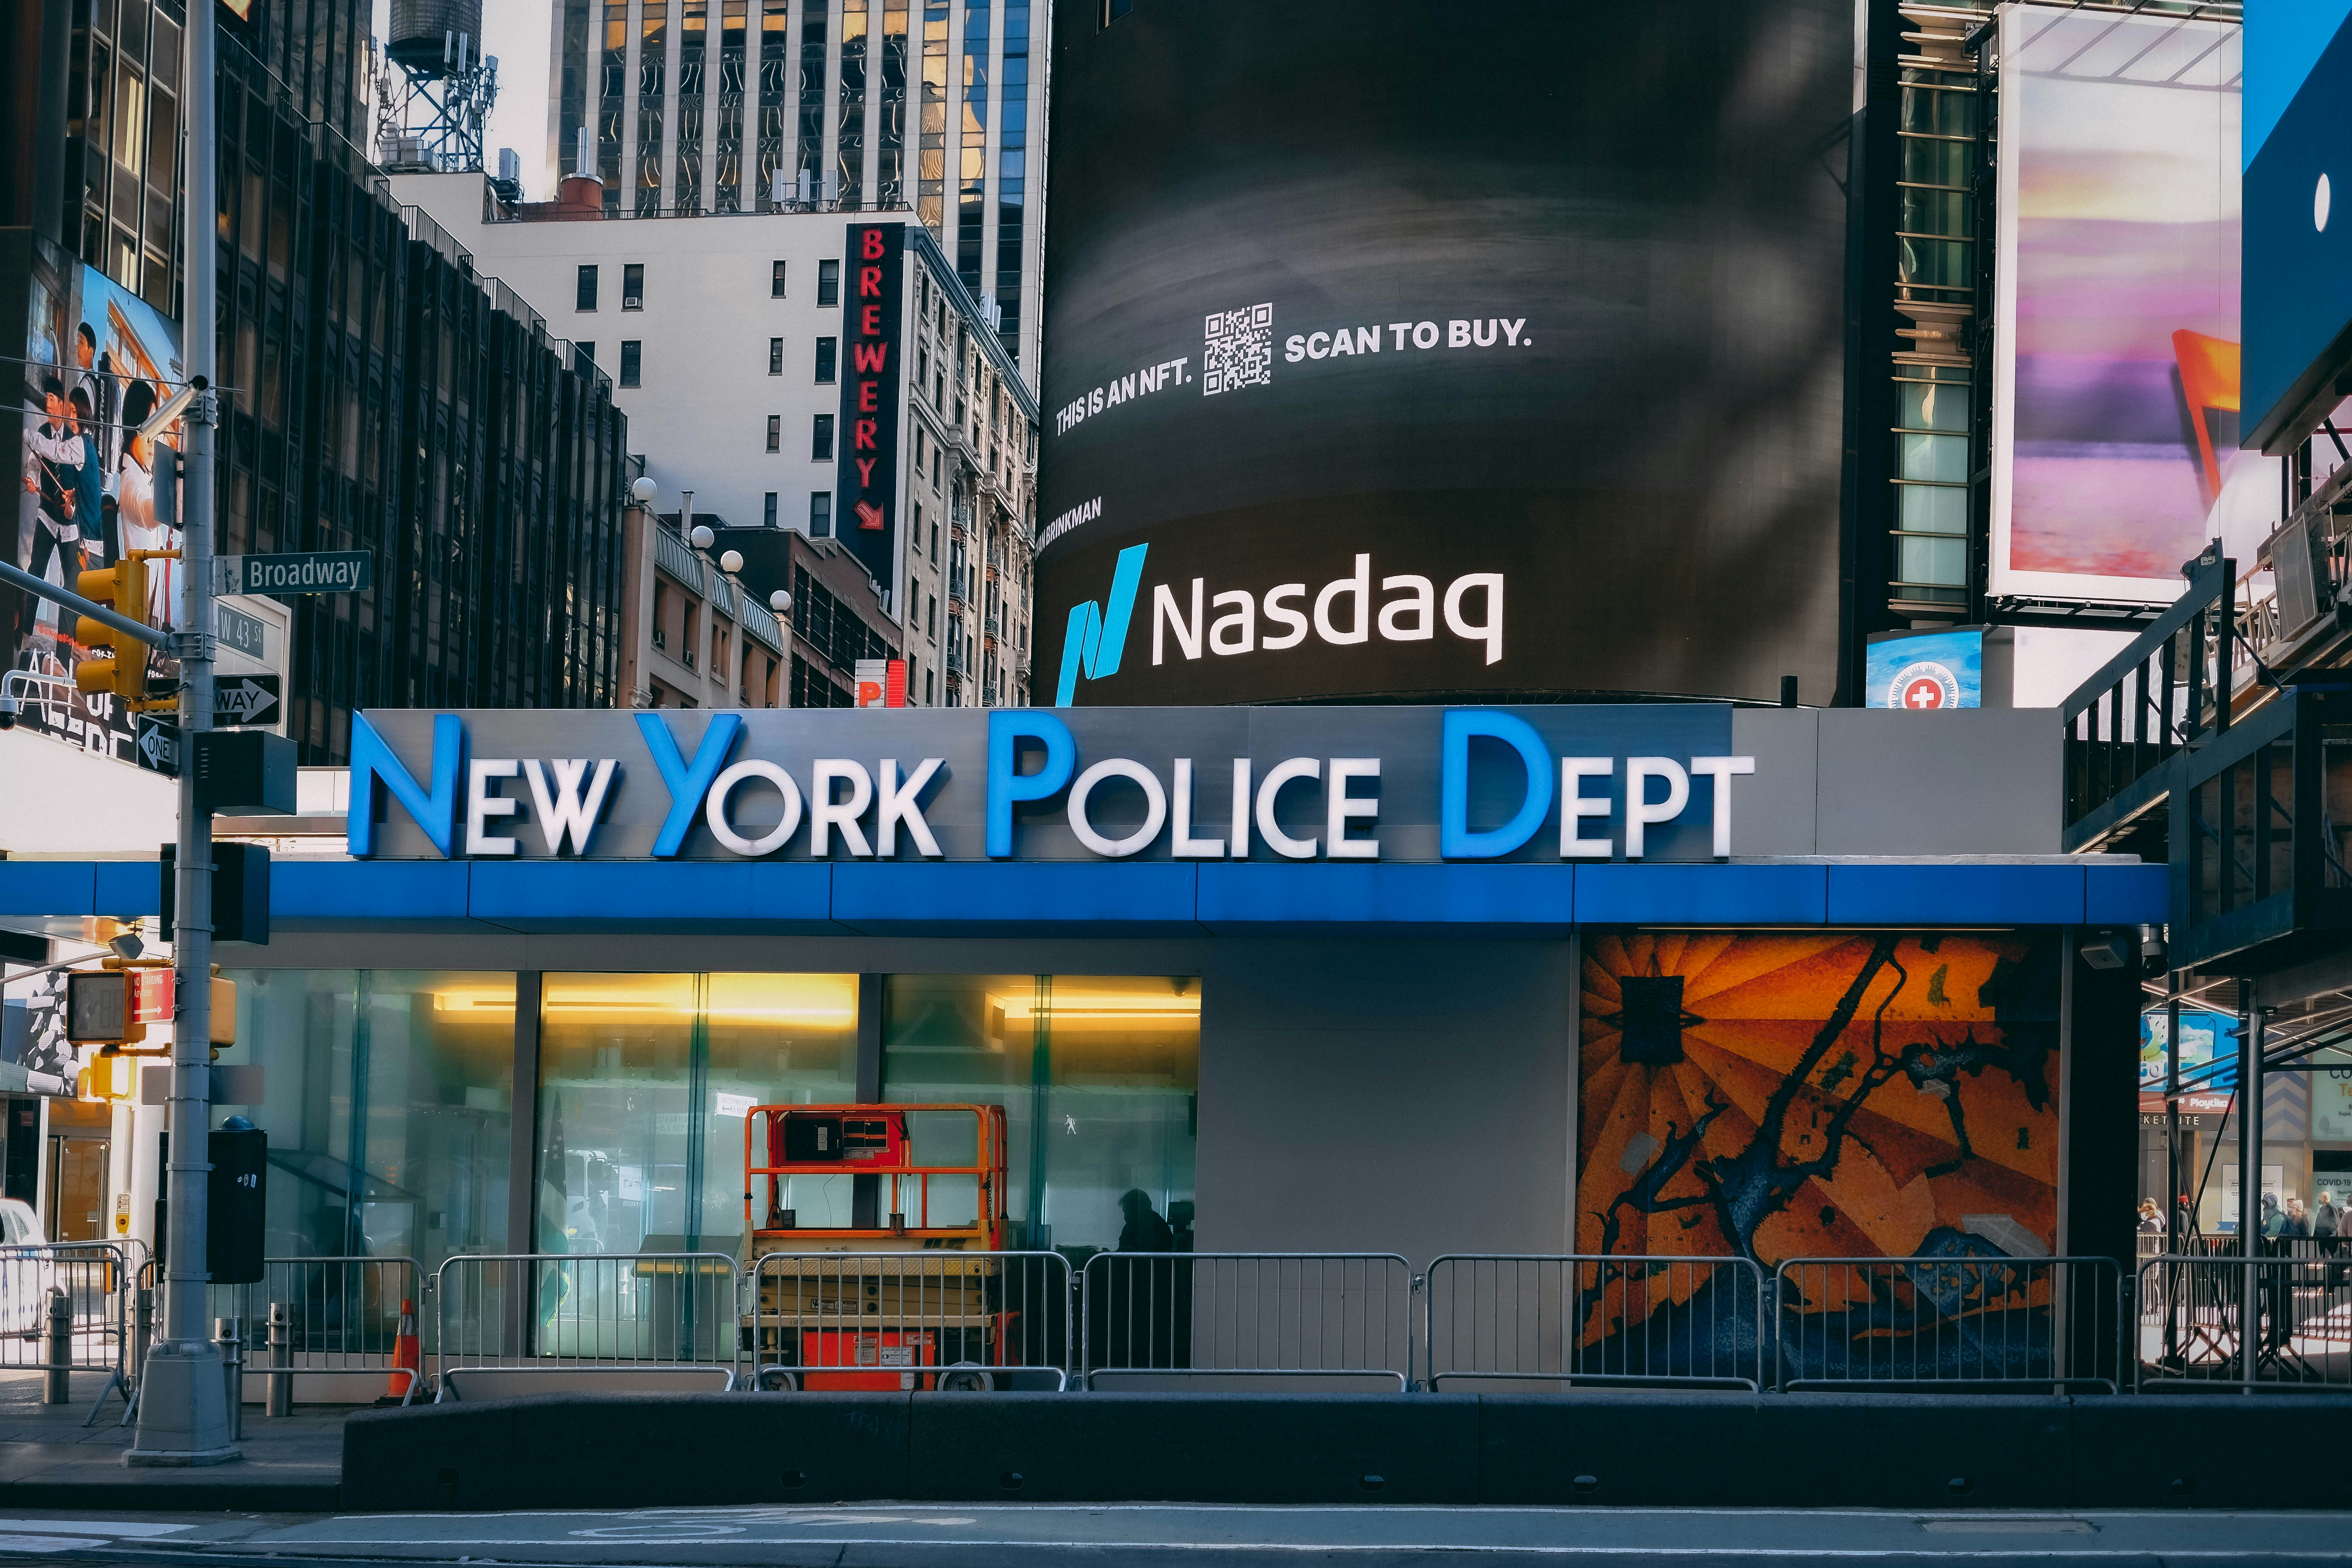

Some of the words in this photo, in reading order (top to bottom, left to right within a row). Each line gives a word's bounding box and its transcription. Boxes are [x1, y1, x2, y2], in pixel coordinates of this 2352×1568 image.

[852, 228, 887, 488] BREWERY
[1285, 325, 1380, 363] SCAN
[1389, 321, 1440, 351] TO
[1448, 318, 1532, 348] BUY.
[1056, 396, 1085, 437] THIS
[1087, 387, 1103, 417] IS
[1107, 373, 1135, 408] AN
[1140, 357, 1192, 396] NFT.
[1046, 496, 1101, 546] BRINKMAN
[251, 557, 361, 590] Broadway
[1152, 553, 1504, 666] Nasdaq
[221, 611, 230, 641] W
[237, 619, 249, 648] 43
[254, 625, 261, 643] St
[20, 648, 83, 736] ALL
[215, 691, 260, 710] WAY
[148, 735, 169, 760] ONE
[134, 977, 140, 986] NO
[142, 975, 163, 985] STANDING
[134, 988, 152, 999] Anytime
[2190, 1098, 2228, 1109] Playtika
